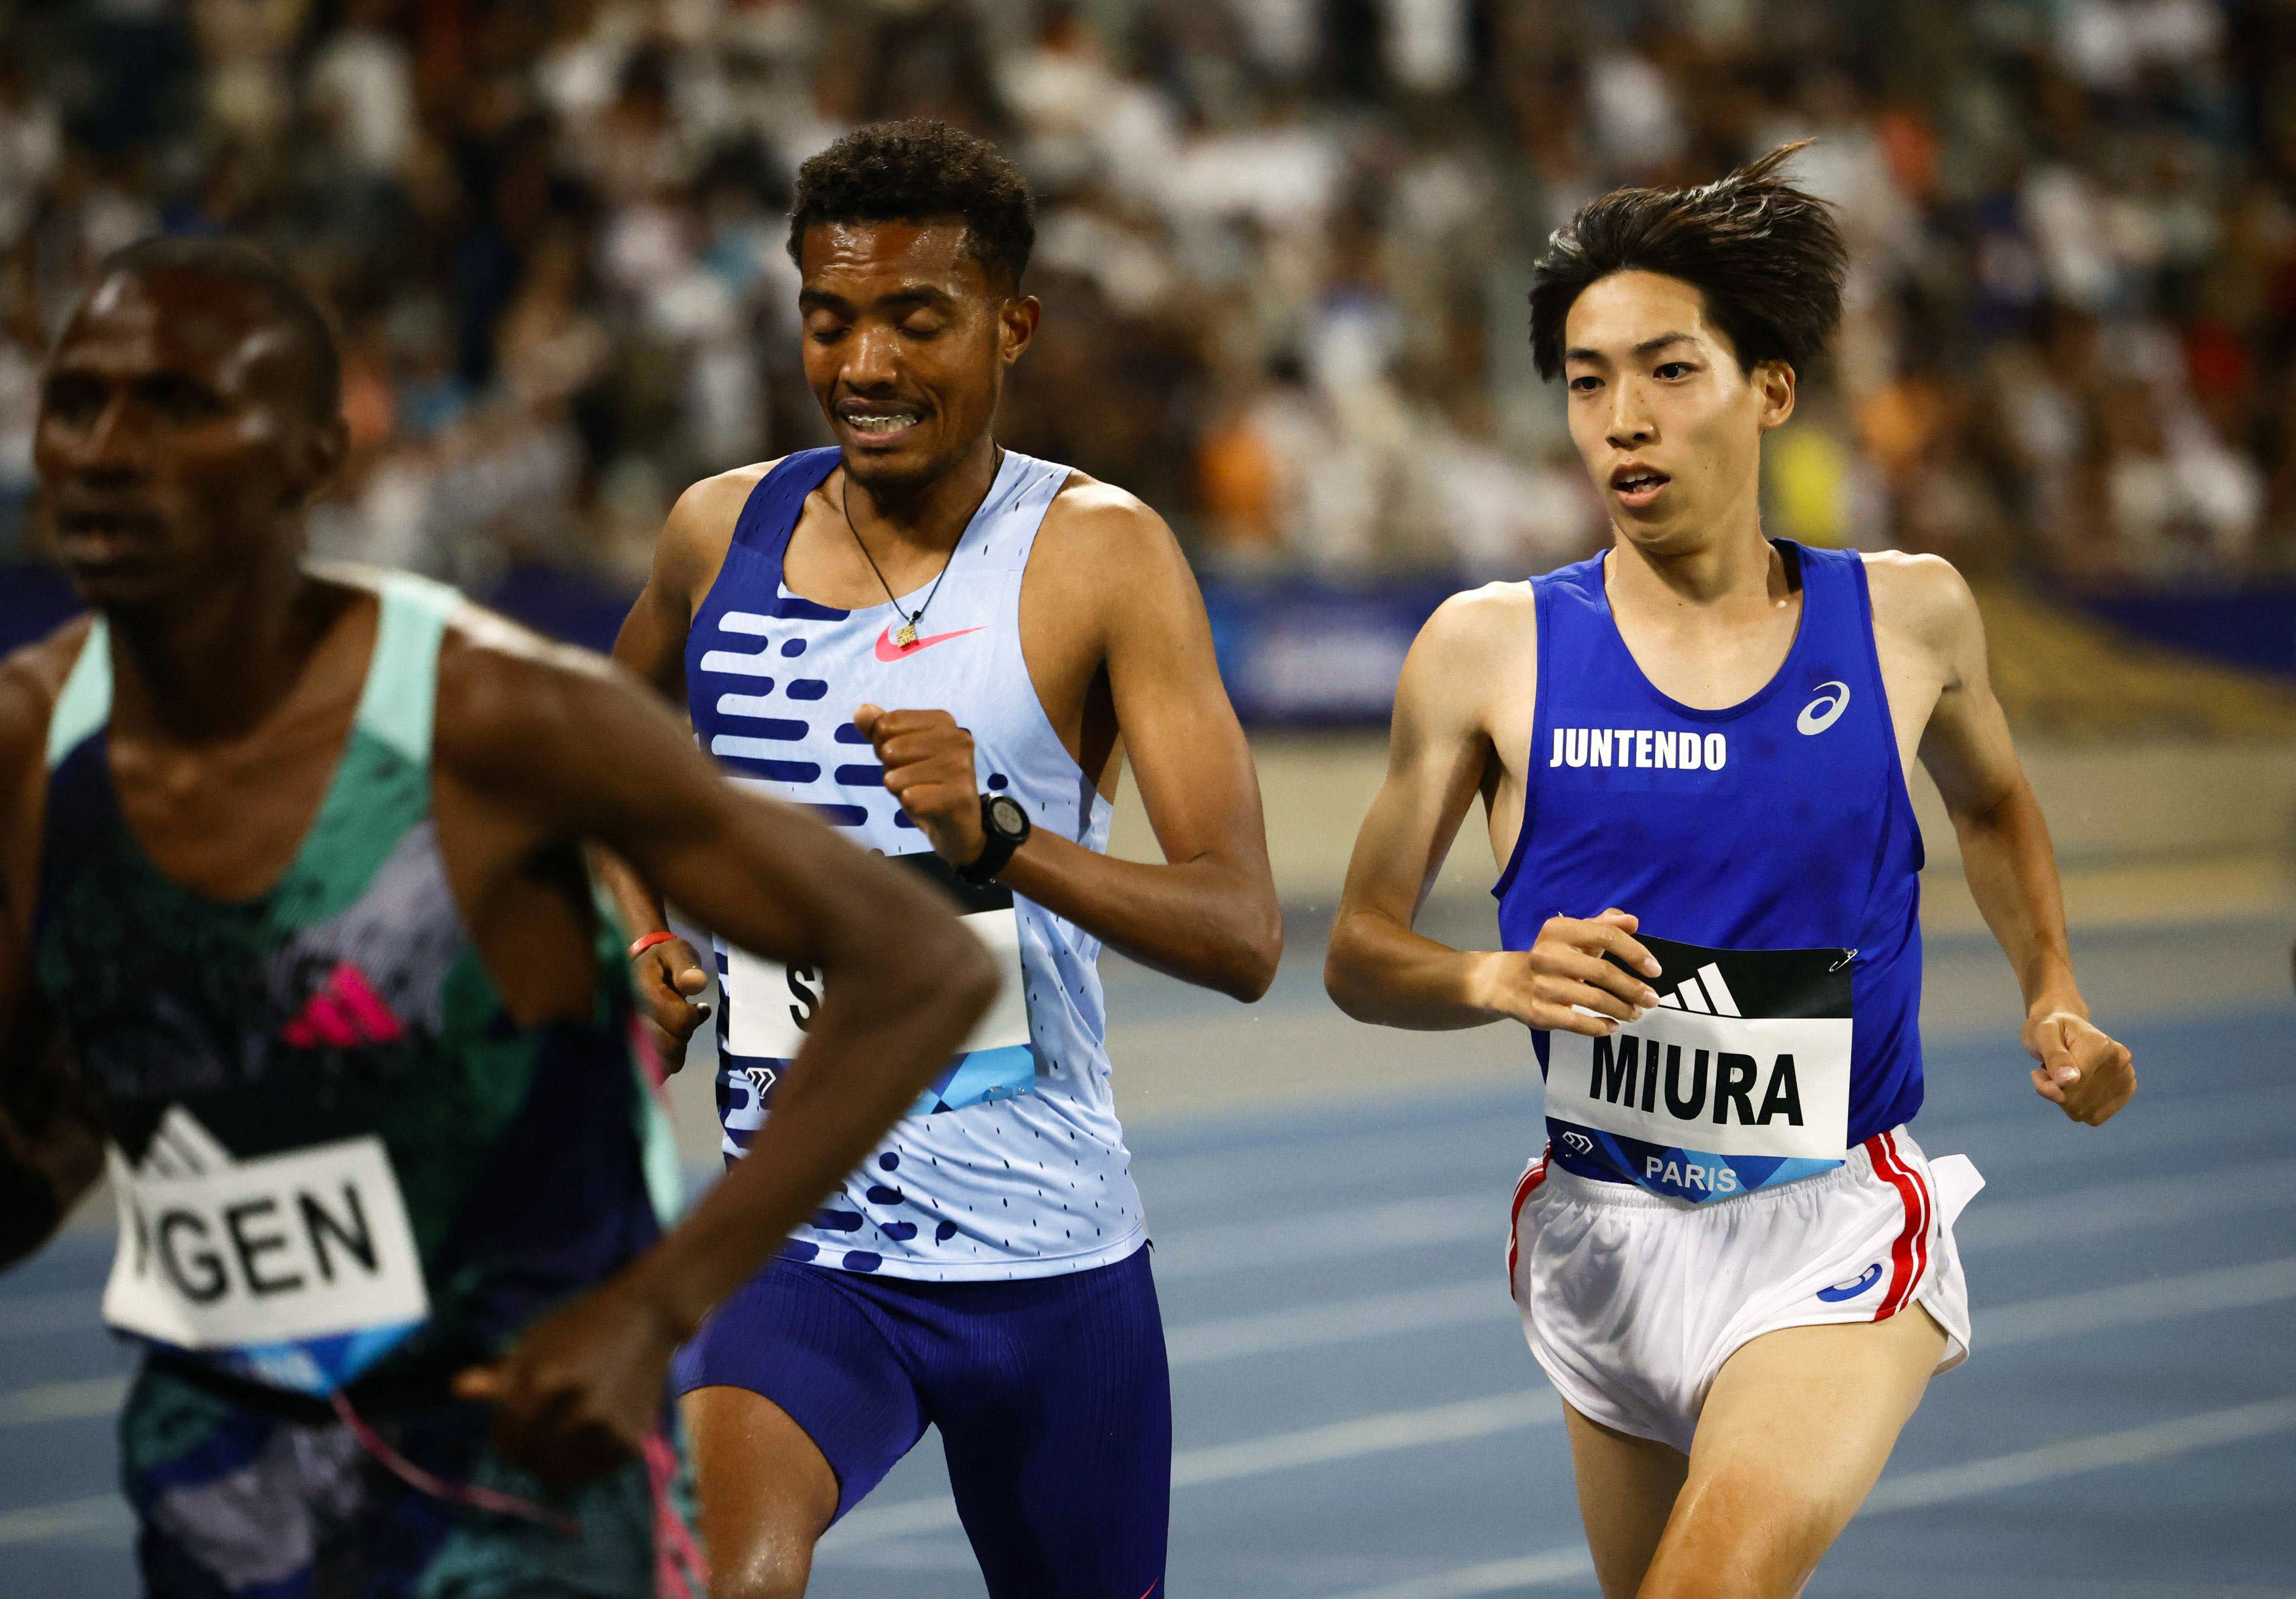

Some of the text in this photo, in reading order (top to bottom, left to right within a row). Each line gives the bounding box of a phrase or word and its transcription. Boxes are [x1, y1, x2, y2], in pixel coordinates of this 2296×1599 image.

[1549, 728, 1727, 771] JUNTENDO
[1589, 1034, 1804, 1126] MIURA
[1646, 1156, 1736, 1192] PARIS
